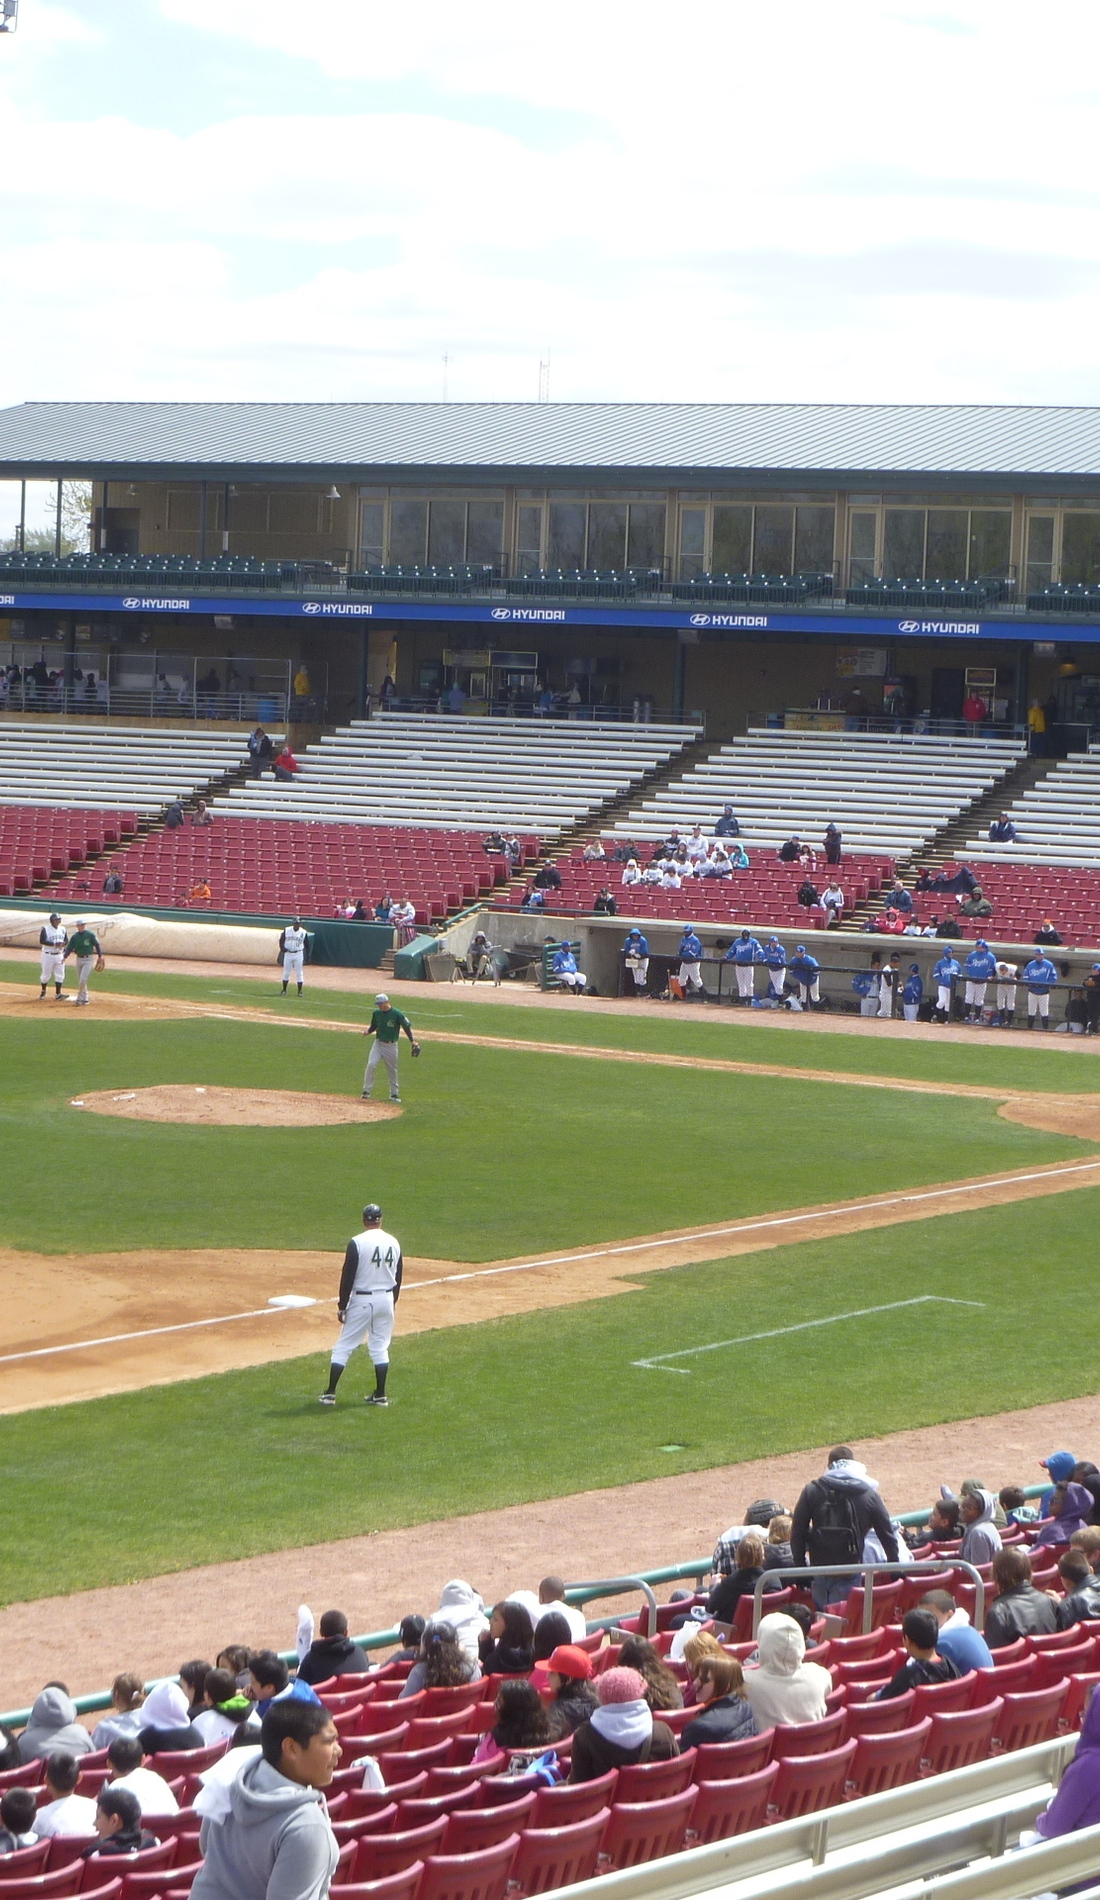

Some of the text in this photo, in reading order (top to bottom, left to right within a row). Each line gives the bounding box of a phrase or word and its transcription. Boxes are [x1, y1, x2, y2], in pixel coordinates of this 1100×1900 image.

[142, 599, 190, 610] HYUNDAI
[322, 603, 372, 615] HYUNDAI
[512, 609, 565, 620] HYUNDAI
[712, 615, 767, 627] HYUNDAI
[921, 622, 980, 634] HYUNDAI
[371, 1246, 394, 1268] 44
